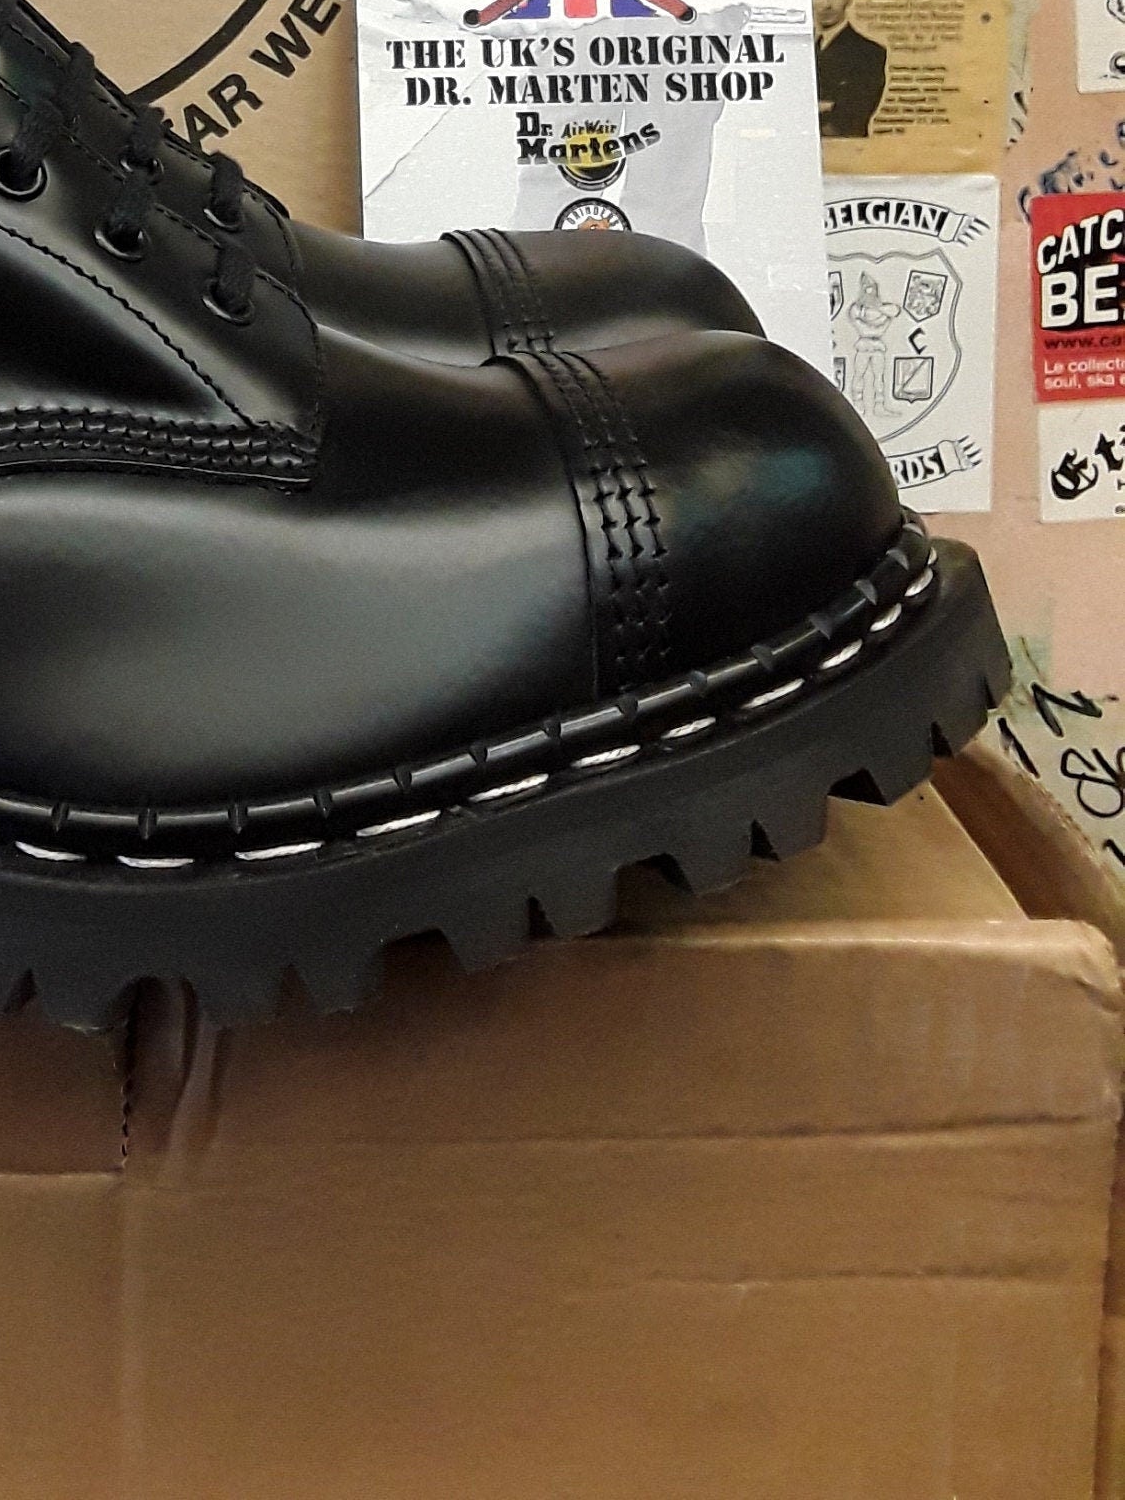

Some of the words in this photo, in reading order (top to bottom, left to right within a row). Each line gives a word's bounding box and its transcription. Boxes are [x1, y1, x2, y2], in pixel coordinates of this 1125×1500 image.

[386, 39, 466, 70] THE
[480, 36, 575, 69] UK'S
[589, 33, 785, 67] ORIGINAL
[405, 76, 472, 107] DR.
[487, 73, 650, 105] MARTEN
[665, 71, 775, 103] SHOP
[516, 111, 554, 137] Dr.
[517, 122, 661, 166] Martens
[1037, 208, 1125, 274] CATC
[1044, 360, 1064, 375] Le
[1044, 374, 1082, 390] soul,
[1086, 373, 1116, 388] ska
